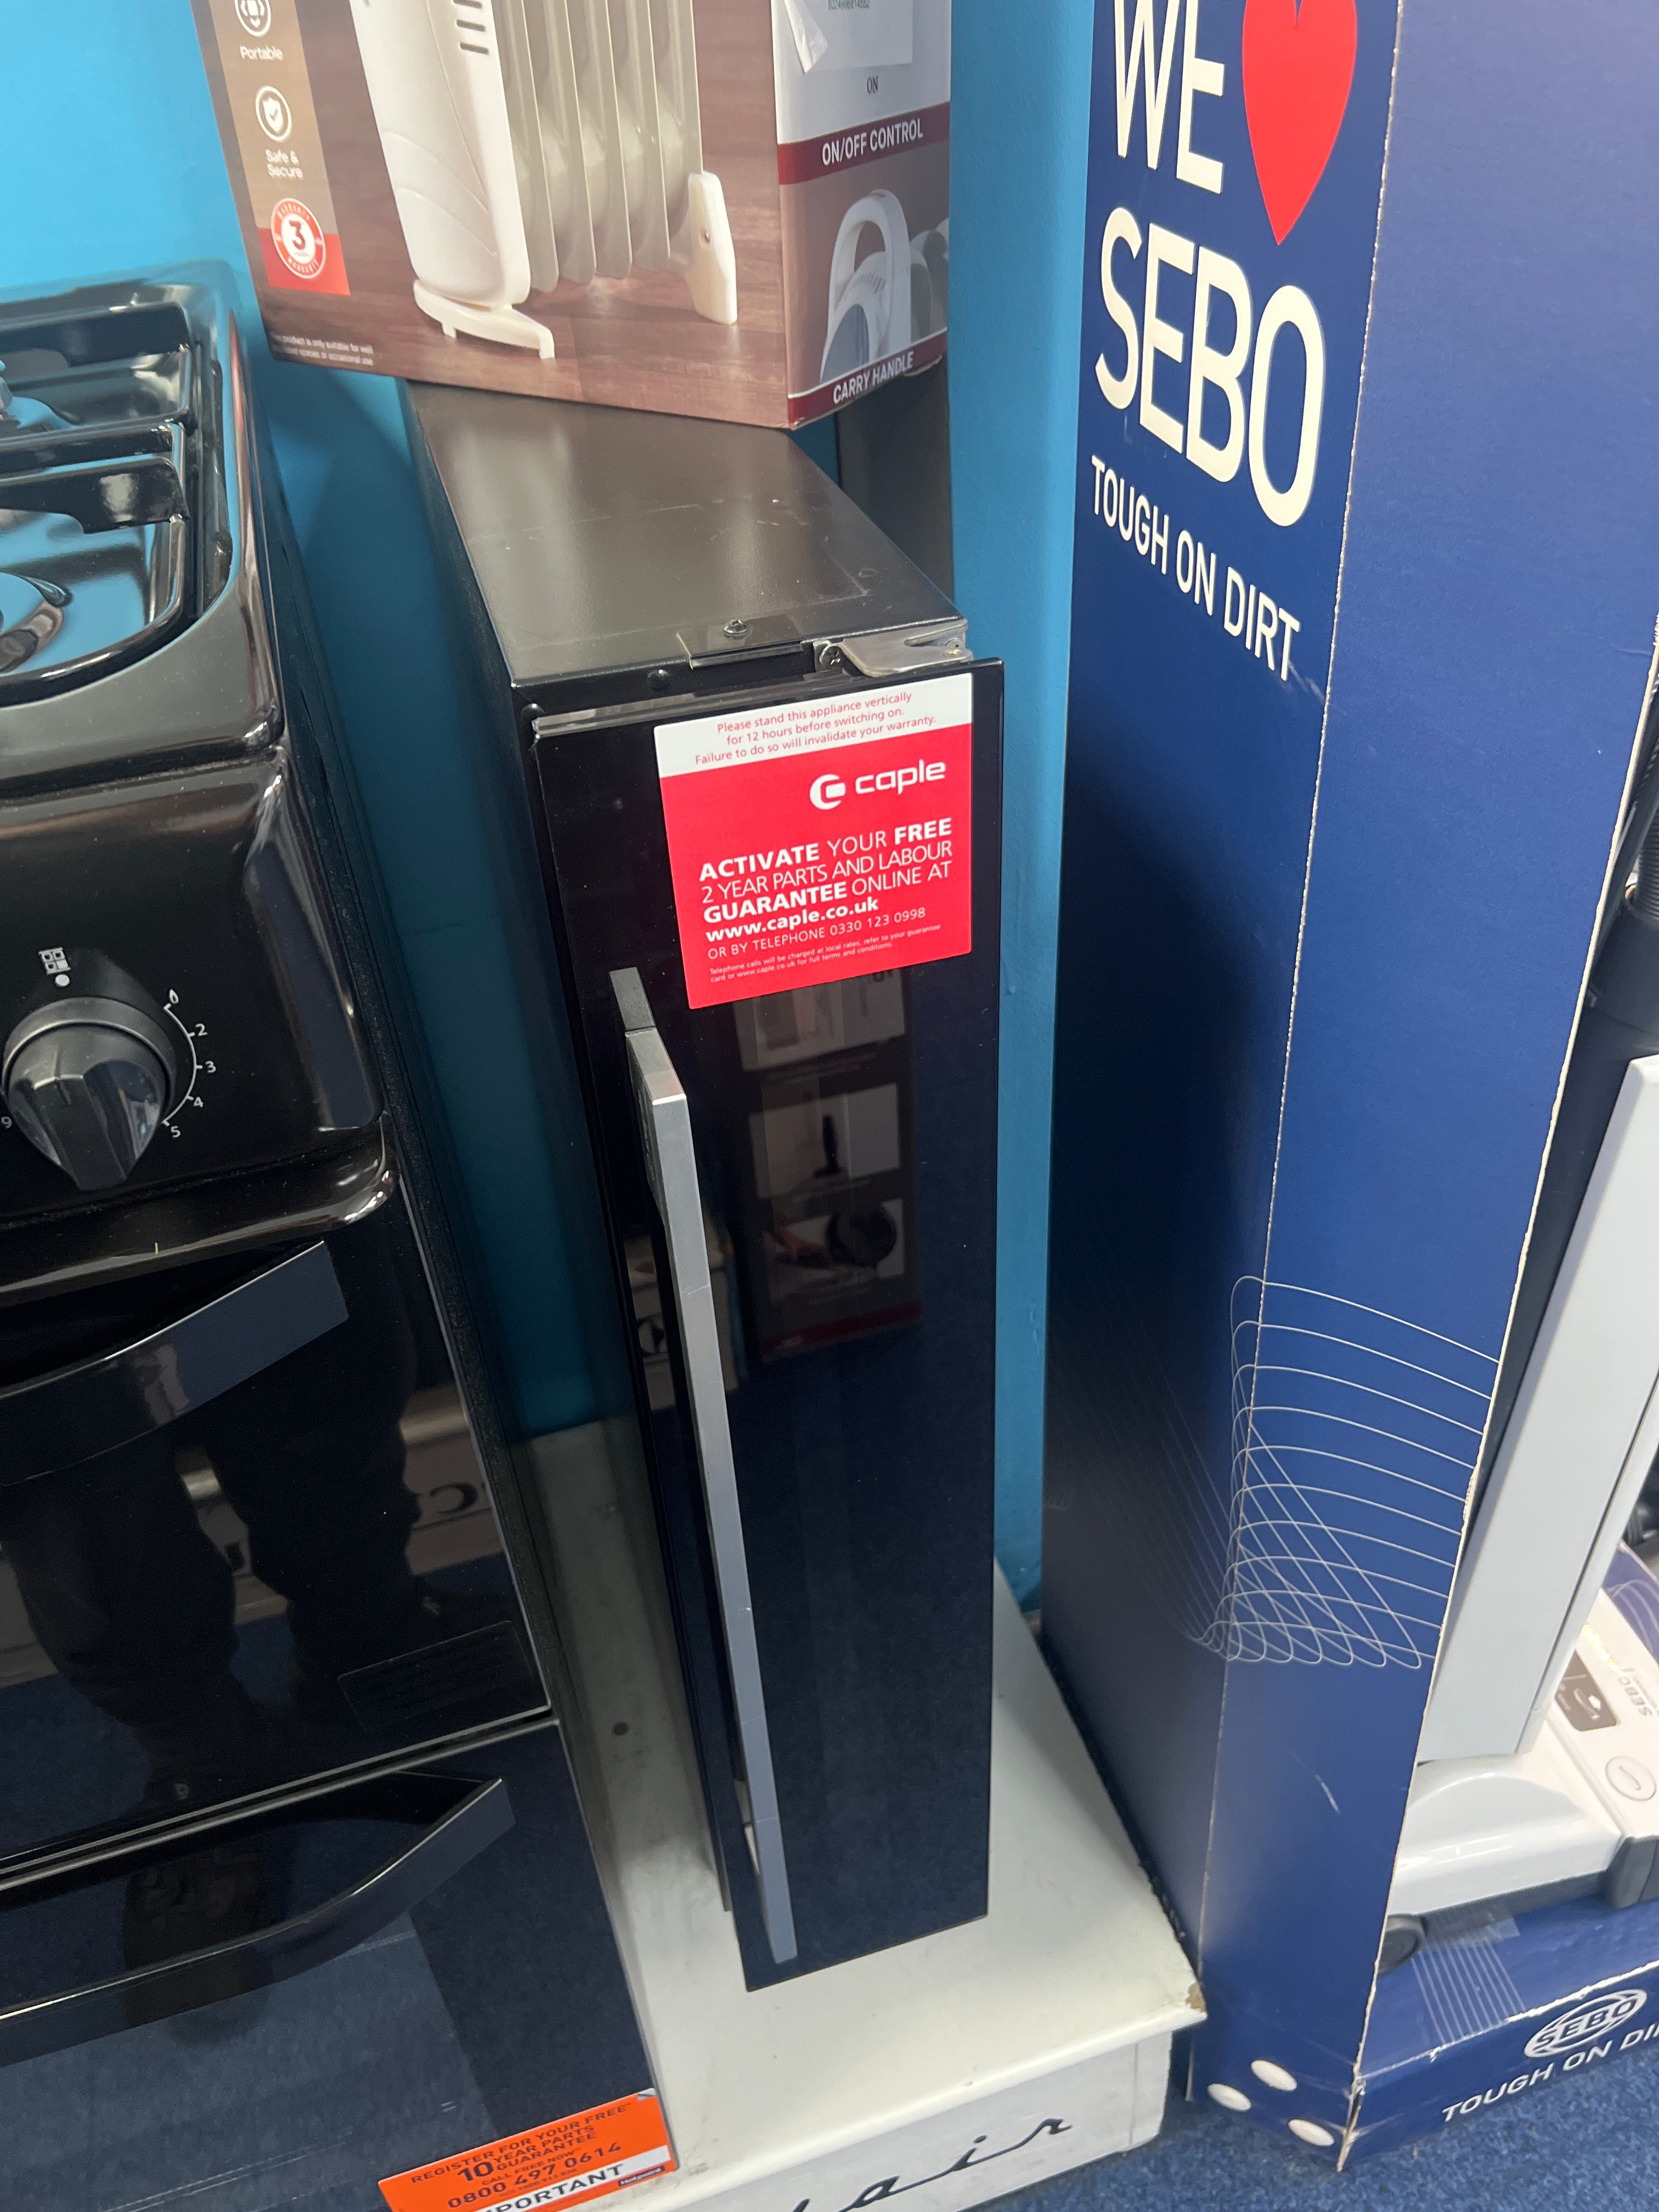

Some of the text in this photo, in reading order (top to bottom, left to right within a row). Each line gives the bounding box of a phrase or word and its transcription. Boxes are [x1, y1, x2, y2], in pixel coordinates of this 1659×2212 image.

[240, 44, 283, 61] Portable
[867, 75, 878, 94] ON
[1113, 0, 1225, 194] WE
[265, 149, 299, 165] Safe &
[822, 118, 923, 166] ON/OFF CONTROL
[267, 163, 303, 180] Secure
[289, 219, 306, 250] 3
[833, 351, 914, 404] CARRY HANDLE
[1094, 207, 1326, 527] SEBO
[1091, 455, 1301, 682] TOUGH ON DIRT
[718, 691, 912, 733] Please stand this appliance vertically
[727, 736, 742, 745] for
[747, 733, 759, 742] 12
[762, 727, 792, 739] hours
[796, 720, 831, 733] before
[834, 712, 884, 727] switching
[695, 716, 936, 765] Failure to do so will invalidate your warranty.
[855, 759, 946, 795] caple
[699, 817, 951, 882] ACTIVATE YOUR FREE
[702, 840, 952, 904] 2 YEAR PARTS AND LABOUR
[703, 860, 952, 923] GUARANTEE ONLINE AT
[706, 896, 878, 942] www.caple.co.uk
[708, 907, 926, 960] OR BY TELEPHONE 0330 123 0998
[710, 963, 744, 975] Telephone
[747, 960, 761, 968] calls
[787, 949, 815, 960] charged
[826, 944, 841, 952] local
[906, 924, 940, 937] guarantee
[711, 974, 725, 983] card
[195, 1024, 207, 1036] 2
[205, 1061, 216, 1073] 3
[1, 1117, 12, 1129] 9
[193, 1096, 204, 1108] 4
[171, 1126, 180, 1138] 5
[1533, 1999, 1638, 2051] SEBO
[1443, 2063, 1554, 2122] TOUGH
[1562, 2040, 1613, 2072] ON
[411, 2151, 494, 2183] REGISTER
[499, 2138, 532, 2153] FOR
[535, 2121, 580, 2140] YOUR
[458, 2125, 594, 2181] 10 YEAR PARTS
[482, 2173, 512, 2185] CALL
[515, 2161, 544, 2174] FREE
[497, 2131, 597, 2170] GUARANTEE
[792, 2118, 1073, 2212] air
[448, 2182, 506, 2208] 0800
[515, 2164, 555, 2185] 497
[565, 2142, 622, 2168] 0614
